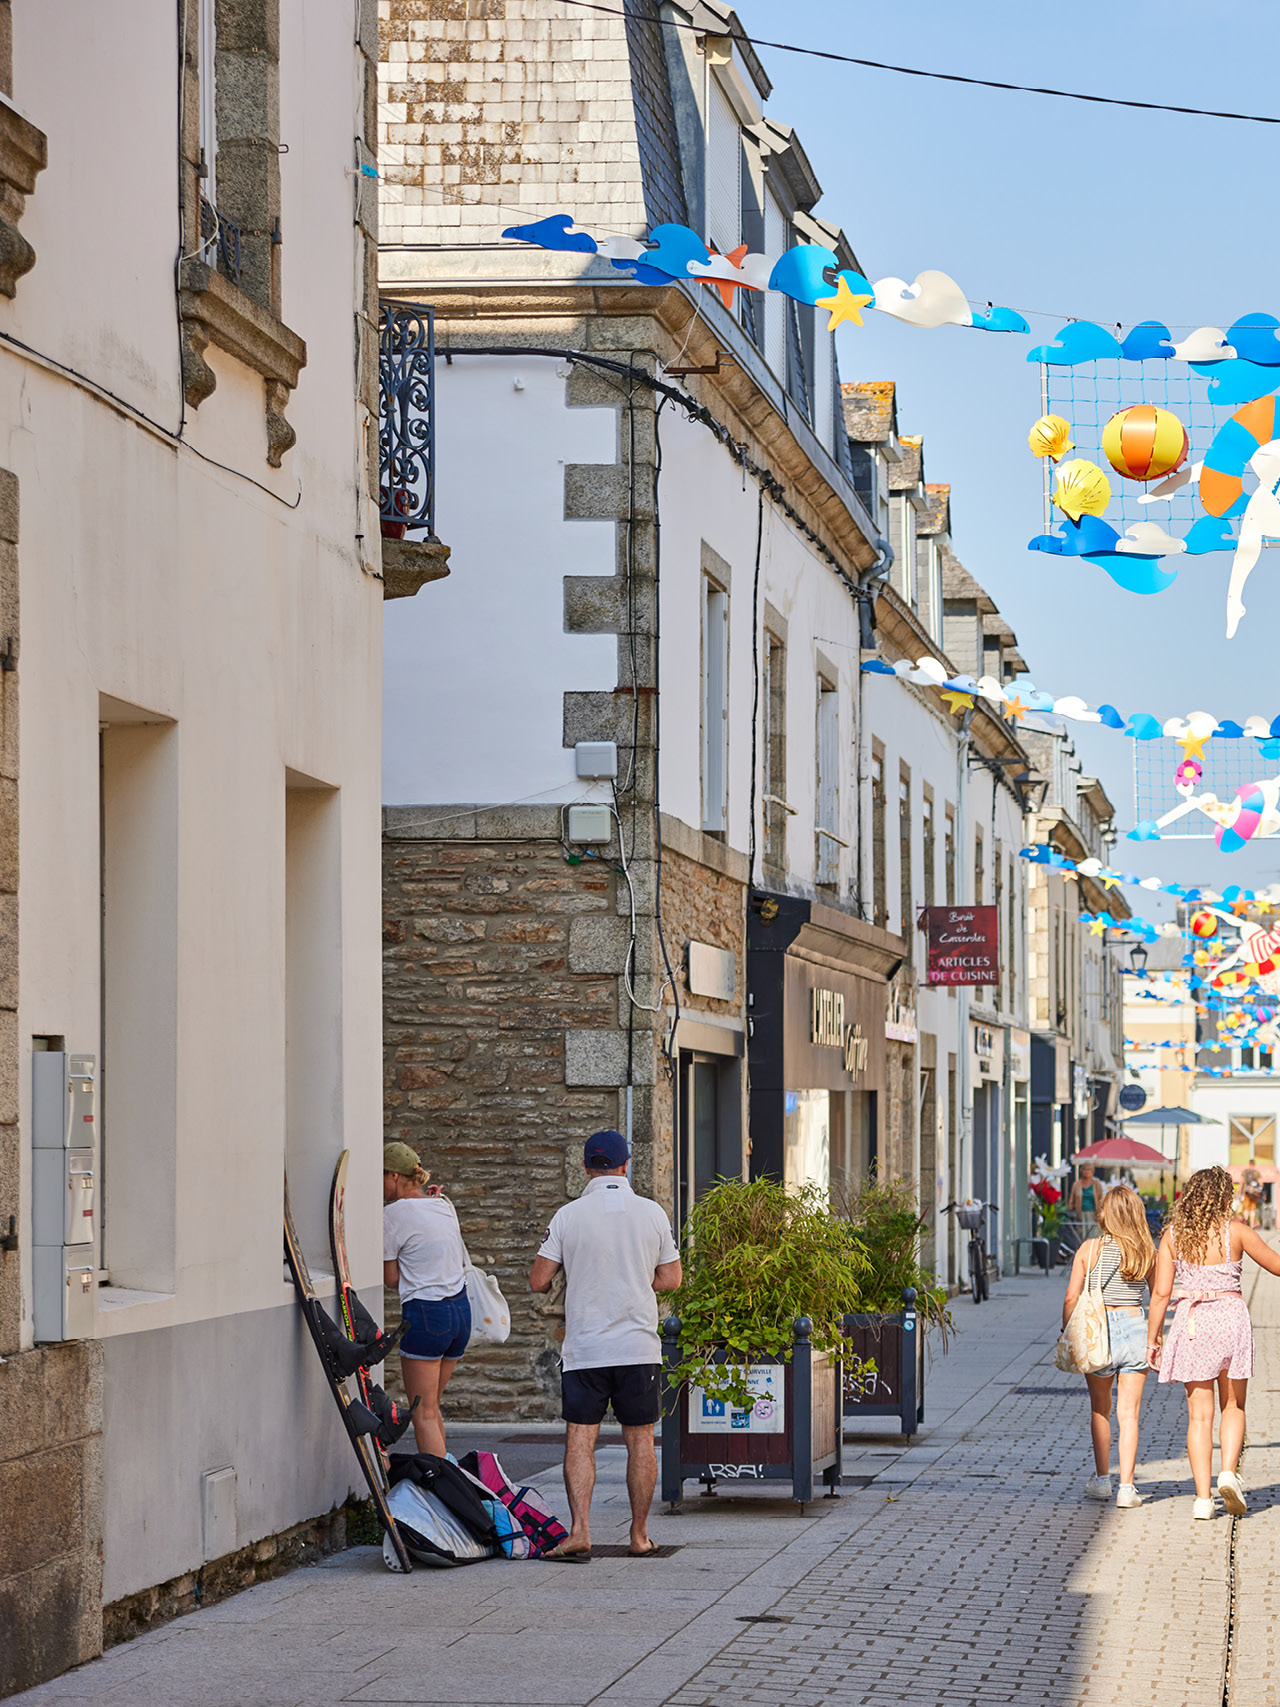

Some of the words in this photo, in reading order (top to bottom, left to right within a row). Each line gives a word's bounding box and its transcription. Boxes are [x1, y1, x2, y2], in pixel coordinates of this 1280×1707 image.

[956, 924, 968, 933] de
[938, 956, 991, 967] ARTICLES
[931, 971, 947, 981] DE
[950, 971, 997, 980] CUISINE
